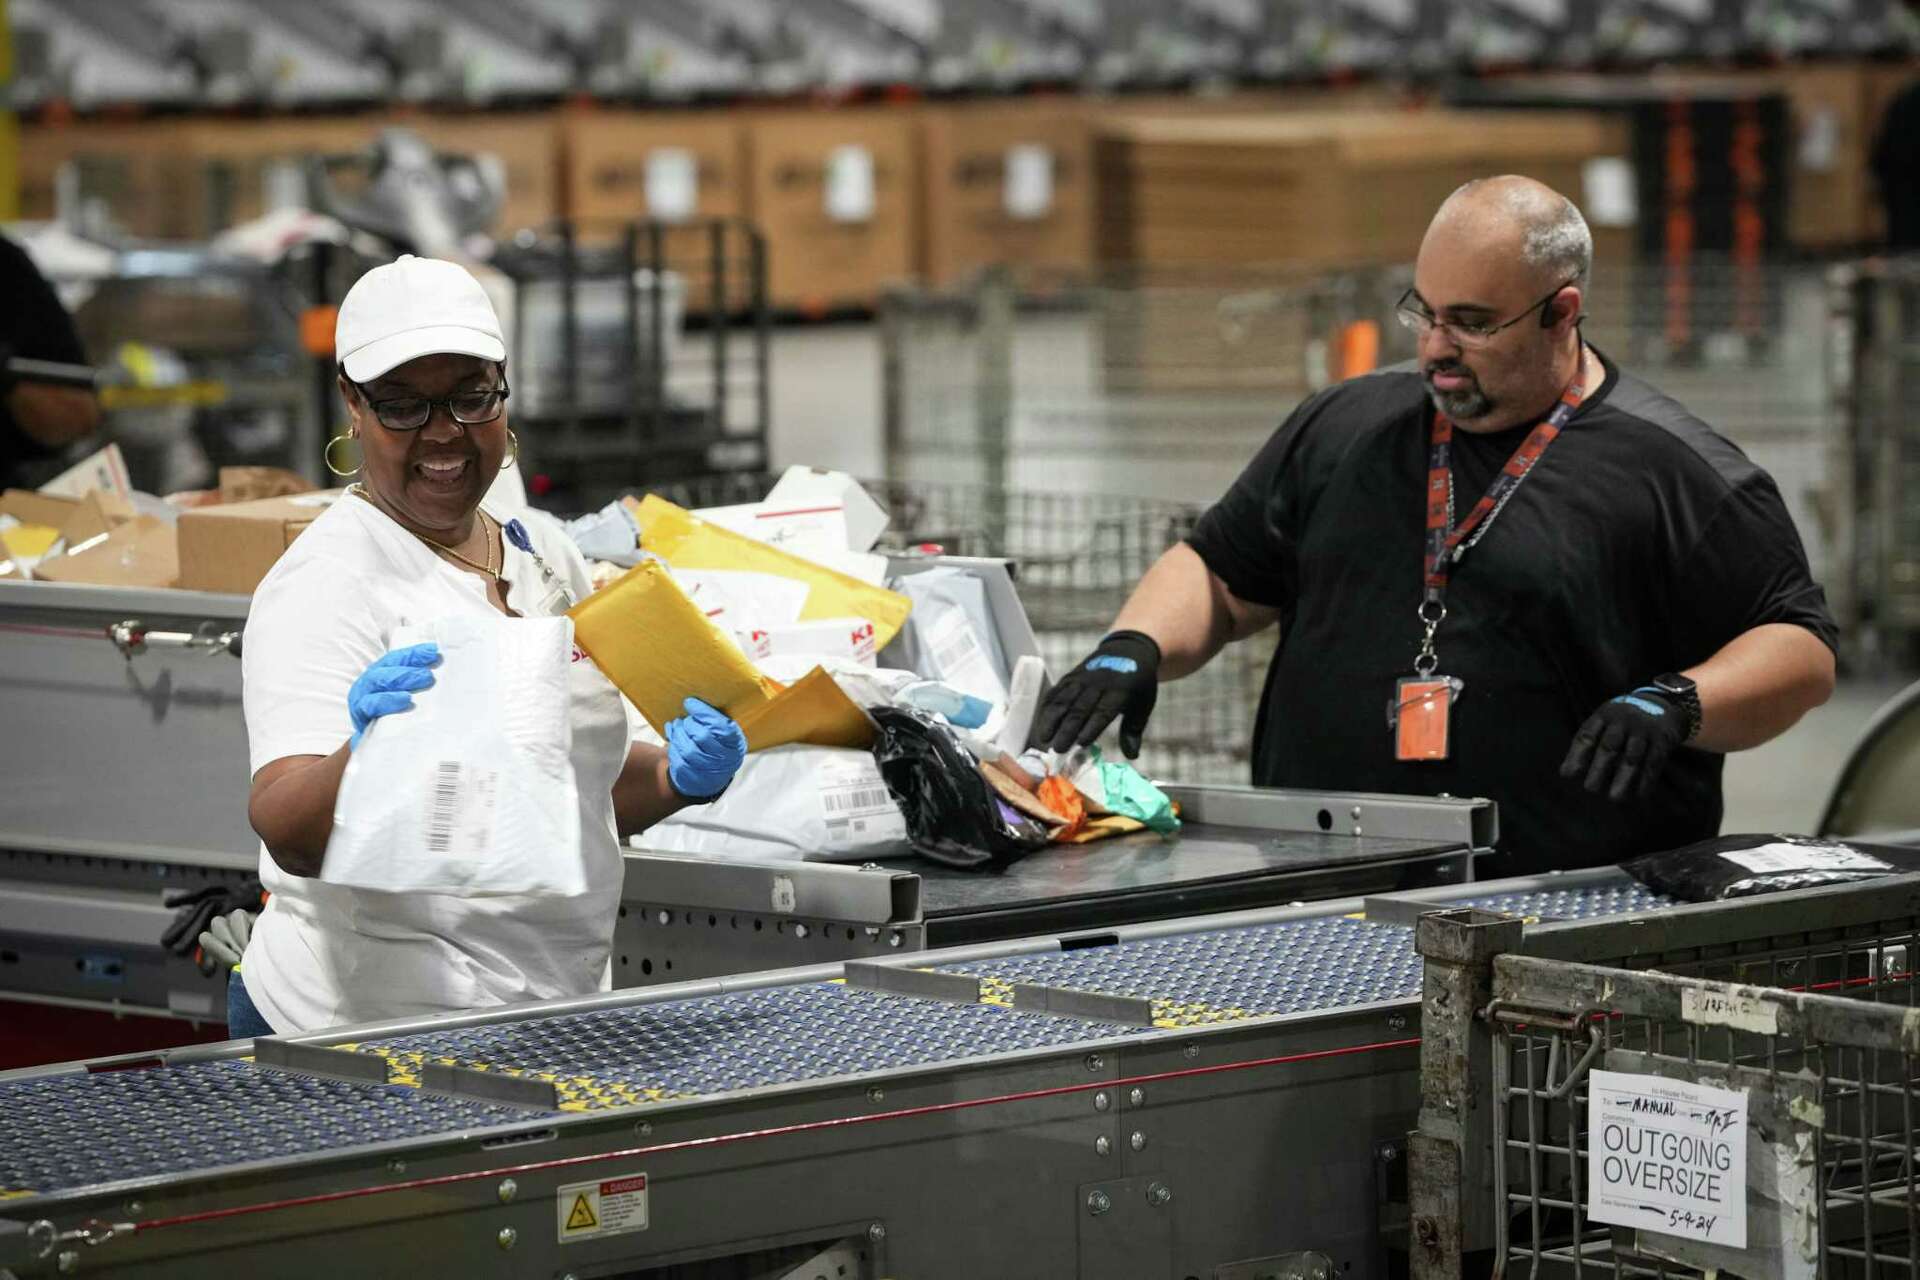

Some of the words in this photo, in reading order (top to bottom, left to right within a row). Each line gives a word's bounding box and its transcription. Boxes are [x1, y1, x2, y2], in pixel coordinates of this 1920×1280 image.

[1632, 1097, 1677, 1117] MANUAL
[1604, 1124, 1731, 1171] OUTGOING
[1603, 1156, 1721, 1202] OVERSIZE
